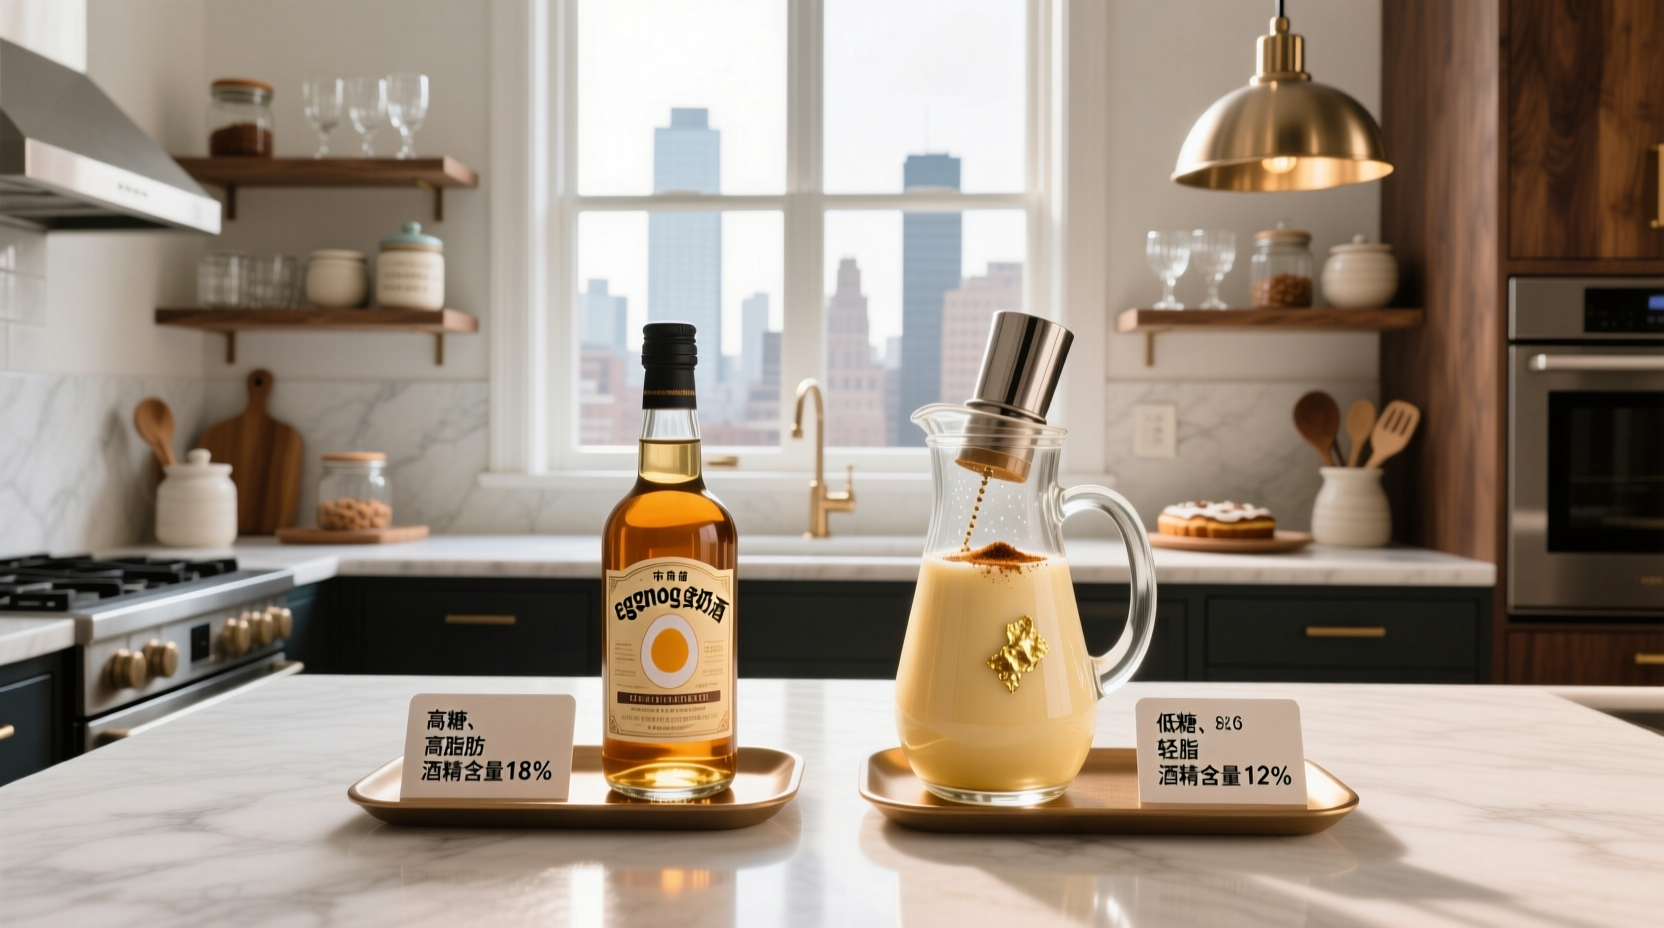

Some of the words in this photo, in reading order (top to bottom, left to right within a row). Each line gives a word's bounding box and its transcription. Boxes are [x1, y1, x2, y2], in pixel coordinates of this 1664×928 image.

[427, 708, 474, 732] 高糖、
[424, 735, 486, 757] 高脂肪
[1157, 738, 1199, 761] 轻脂
[421, 759, 552, 783] 酒精含量18%
[1158, 763, 1292, 787] 酒精含量12%
